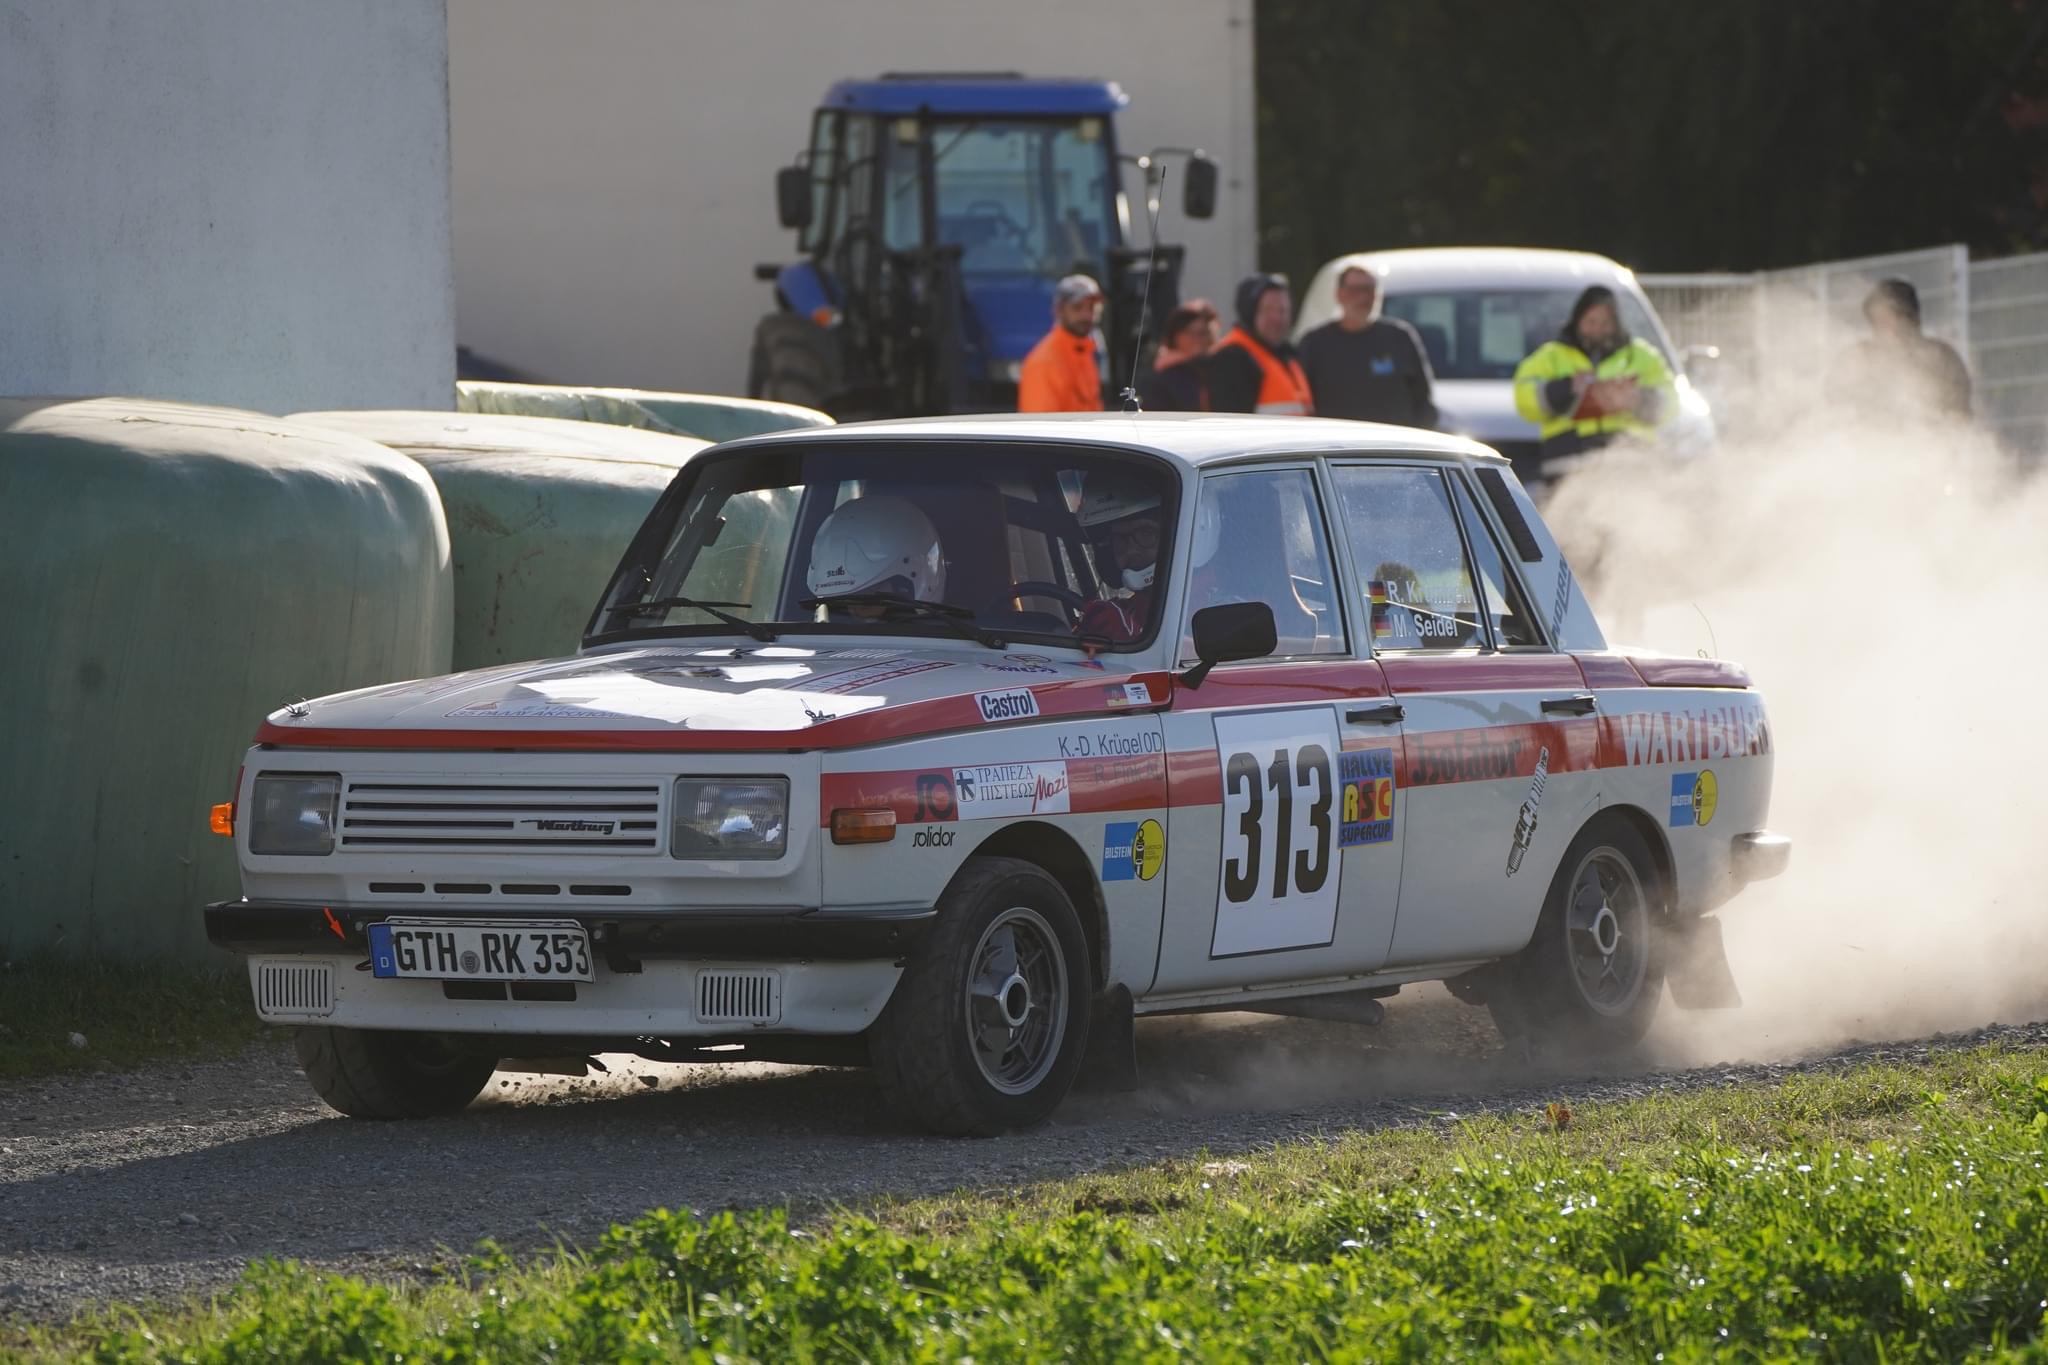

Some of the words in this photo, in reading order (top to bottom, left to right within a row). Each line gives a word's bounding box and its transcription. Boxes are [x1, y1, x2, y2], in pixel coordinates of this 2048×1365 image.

[1387, 581, 1404, 602] R.
[1393, 614, 1411, 637] M.
[1414, 614, 1458, 637] Seidel
[980, 690, 1034, 719] Castrol
[1097, 732, 1143, 757] Krügel
[976, 765, 1034, 783] ΤΡΑΠΕΖΑ
[1341, 752, 1392, 779] RALLYE
[1343, 780, 1391, 823] RSC
[1224, 744, 1332, 903] 313
[1342, 822, 1391, 843] SUPERCUP
[1104, 846, 1132, 859] BILSTEIN
[380, 956, 390, 969] D
[395, 930, 458, 972] GTH
[481, 932, 526, 974] RK
[530, 934, 590, 976] 353
